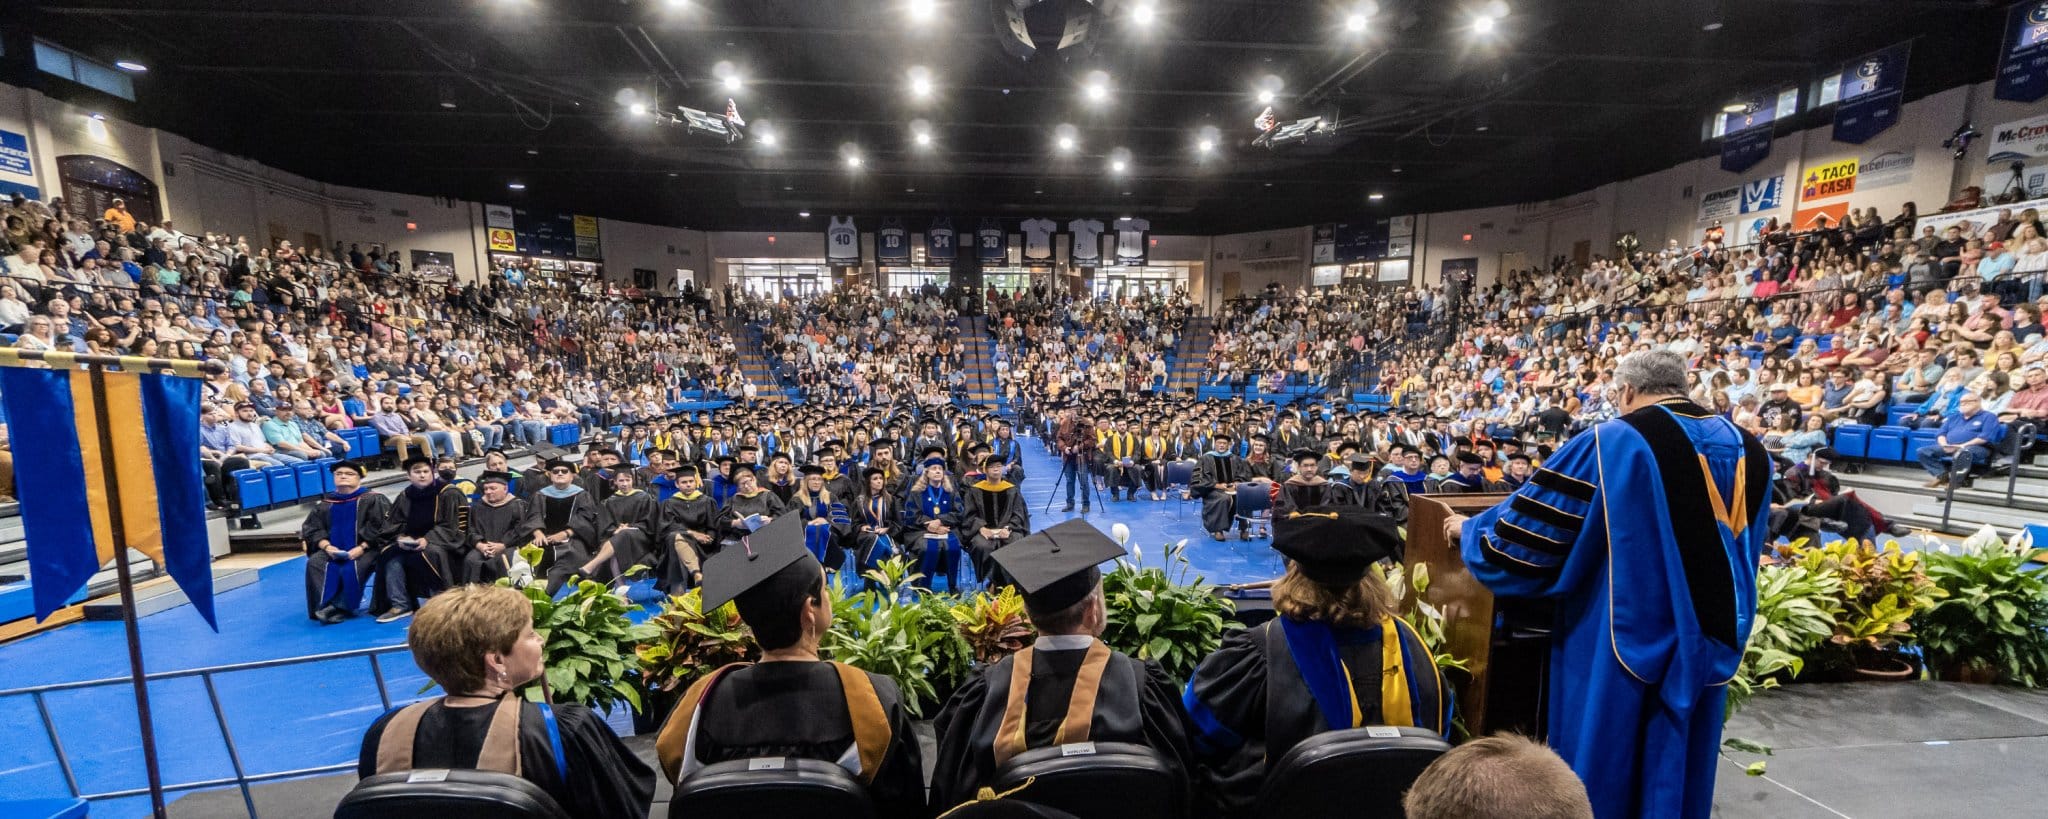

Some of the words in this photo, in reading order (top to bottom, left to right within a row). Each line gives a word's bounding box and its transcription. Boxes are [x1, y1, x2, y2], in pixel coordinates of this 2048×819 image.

[1822, 163, 1856, 181] TACO
[1820, 178, 1852, 195] CASA
[835, 234, 850, 245] 40
[886, 235, 899, 248] 10
[934, 236, 949, 248] 34
[983, 236, 998, 248] 30
